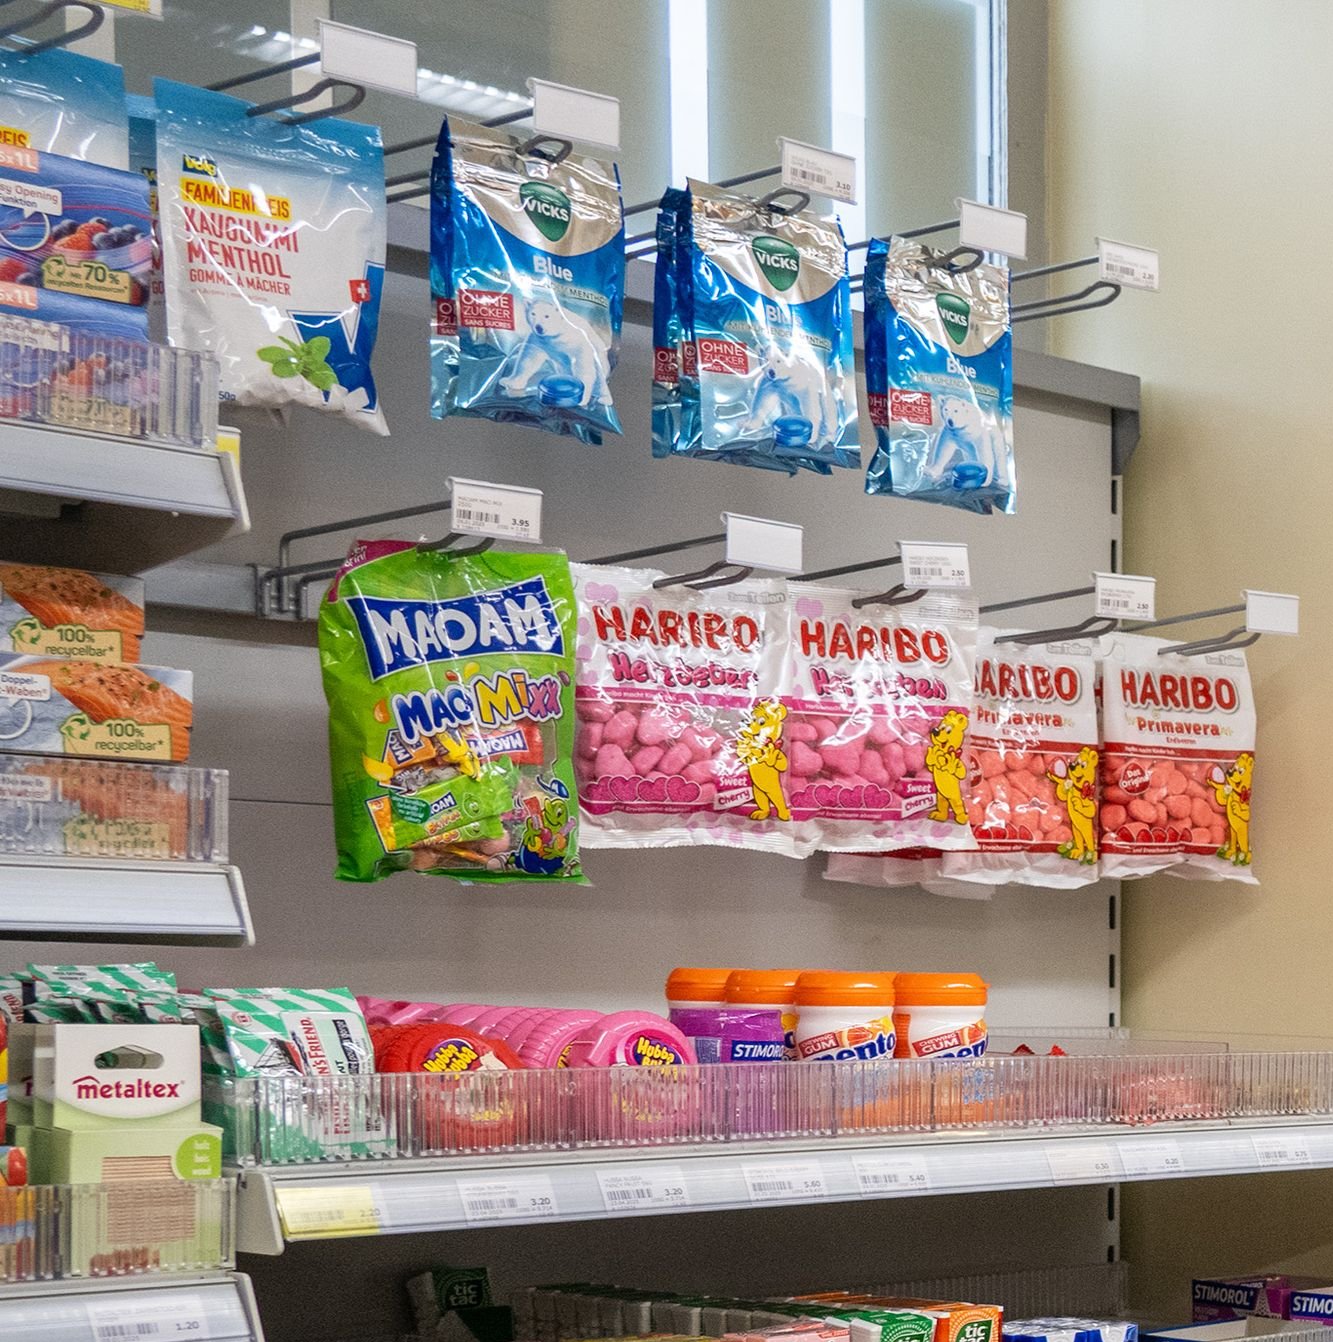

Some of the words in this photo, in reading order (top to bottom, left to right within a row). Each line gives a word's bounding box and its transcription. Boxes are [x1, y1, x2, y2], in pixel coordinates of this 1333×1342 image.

[15, 186, 58, 205] Opening
[526, 200, 570, 222] VICKS
[532, 255, 574, 282] Blue
[756, 251, 799, 272] VICKS
[189, 268, 233, 286] GOMME
[462, 306, 512, 319] ZUCKER
[939, 306, 968, 327] VICKS
[701, 342, 744, 356] OHNE
[703, 353, 746, 366] ZUCKER
[511, 517, 530, 528] 3.95
[56, 628, 96, 644] 100%
[369, 595, 550, 666] MAOAM
[592, 604, 760, 654] HARIBO
[800, 619, 949, 665] HARIBO
[1120, 667, 1237, 711] HARIBO
[106, 722, 145, 738] 100%
[1136, 715, 1222, 737] Primavera
[719, 775, 748, 789] Sweet
[906, 782, 932, 795] Sweet
[718, 788, 751, 807] Cherry
[905, 796, 934, 814] Cherry
[637, 1036, 674, 1064] Hubba
[803, 1039, 836, 1055] GUM
[922, 1037, 960, 1054] GUM
[424, 1044, 460, 1073] Hubba
[72, 1074, 180, 1100] metaltex
[664, 1187, 683, 1196] 3.20
[803, 1180, 821, 1189] 5.60
[531, 1197, 550, 1206] 3.20
[453, 1283, 478, 1296] tic
[1193, 1287, 1251, 1306] STIMOROL
[175, 1321, 200, 1332] 1.20
[965, 1323, 986, 1338] tic
